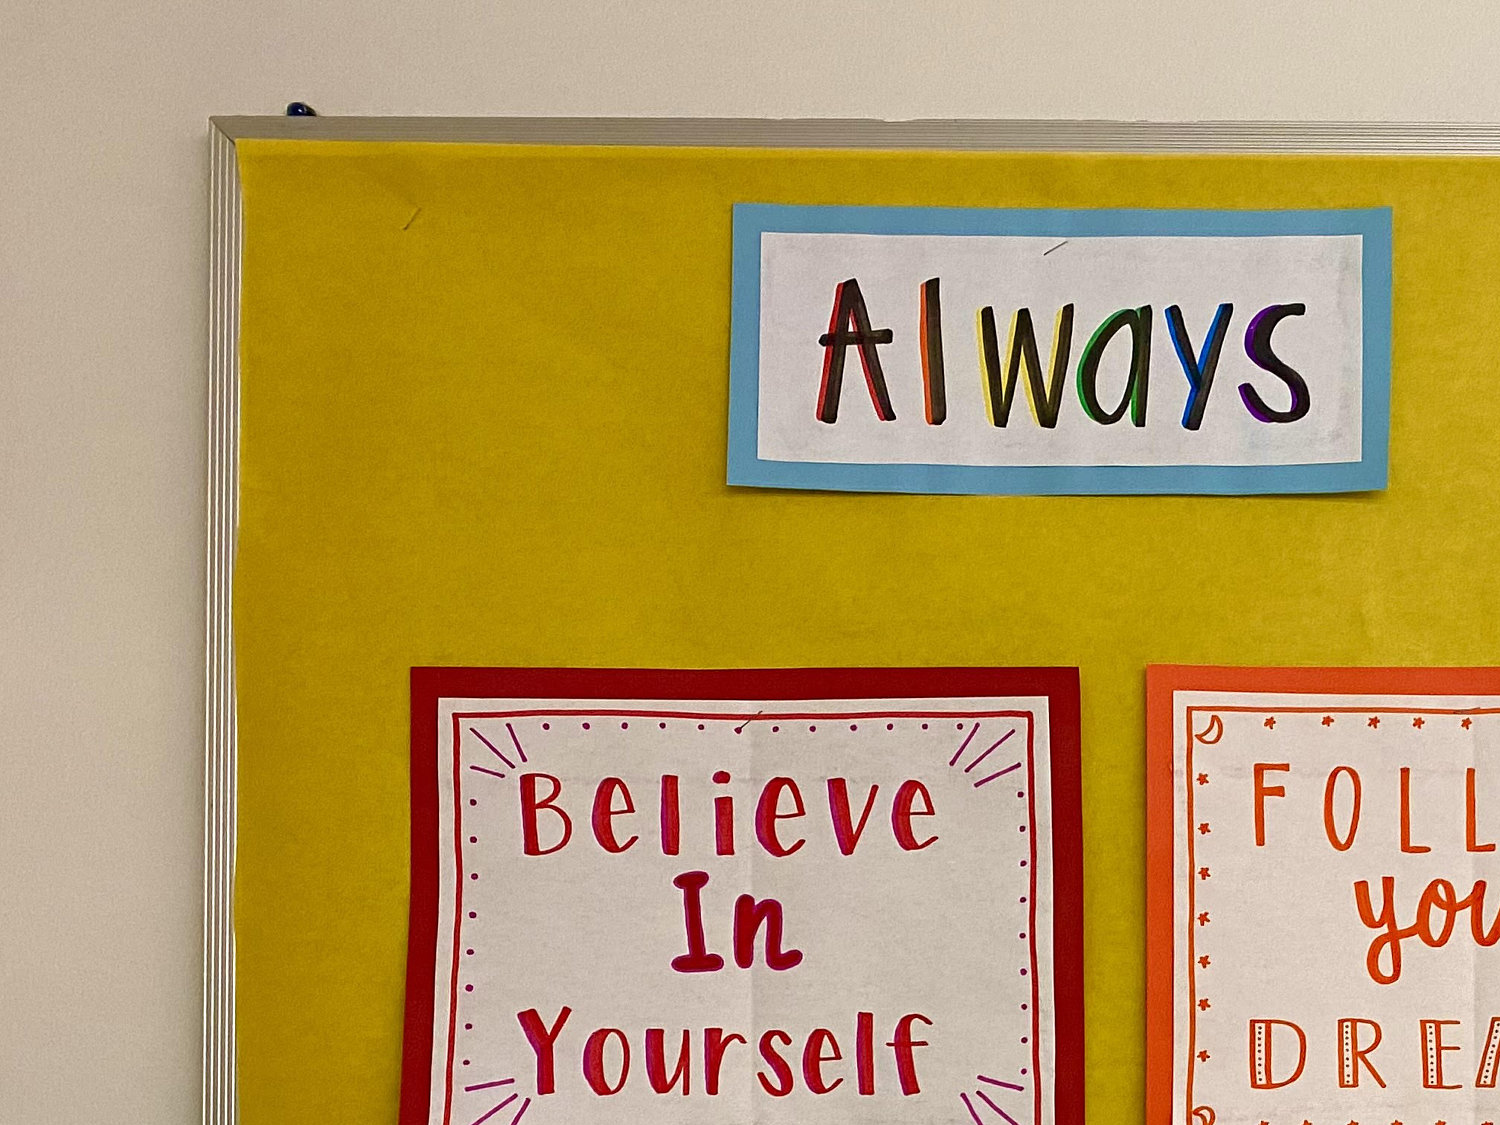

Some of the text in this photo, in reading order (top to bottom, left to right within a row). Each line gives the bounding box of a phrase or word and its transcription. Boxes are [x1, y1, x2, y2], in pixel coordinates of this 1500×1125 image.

[816, 277, 1310, 431] Always
[520, 771, 938, 857] Believe
[671, 871, 803, 973] In
[517, 1006, 933, 1097] Yourself
